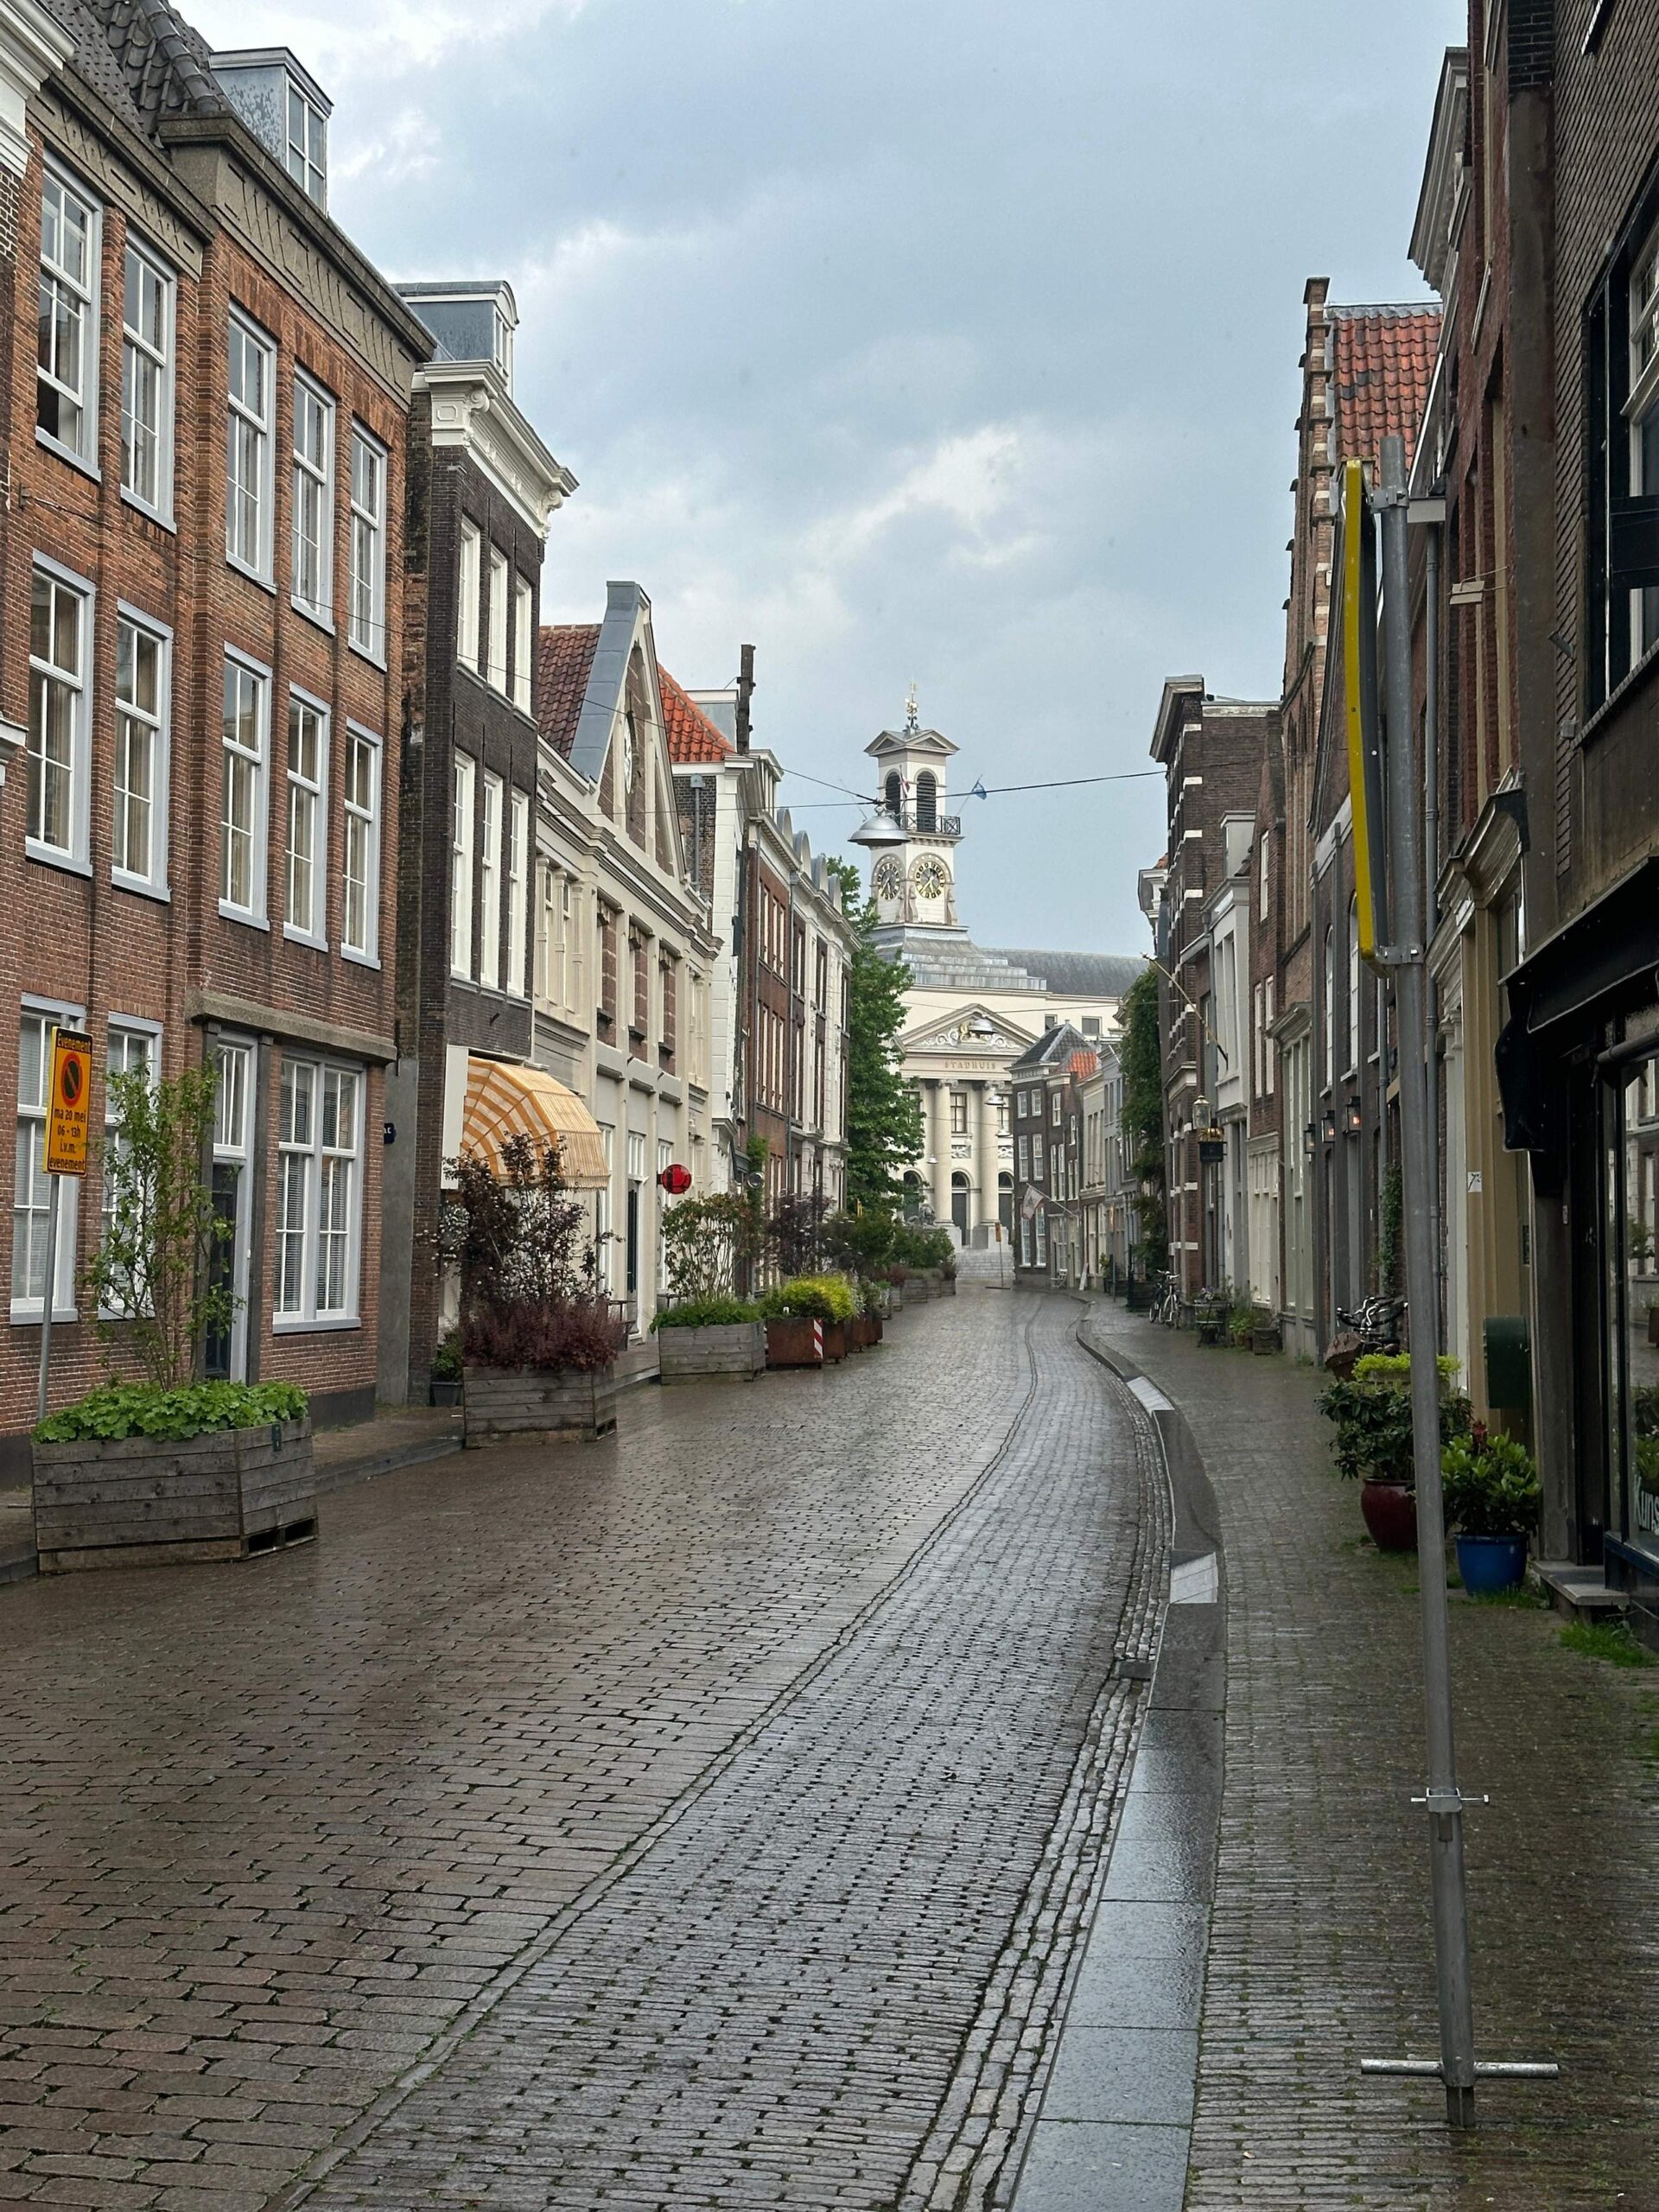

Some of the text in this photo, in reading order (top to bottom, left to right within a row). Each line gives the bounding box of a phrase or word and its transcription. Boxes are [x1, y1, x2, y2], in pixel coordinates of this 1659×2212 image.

[57, 1033, 92, 1053] Evenement
[944, 1061, 996, 1070] STADHUIS
[54, 1108, 86, 1122] ma 20 mei
[57, 1124, 66, 1136] 06
[71, 1125, 81, 1138] 13h
[60, 1138, 76, 1154] i.v.m.
[49, 1157, 85, 1171] evenement
